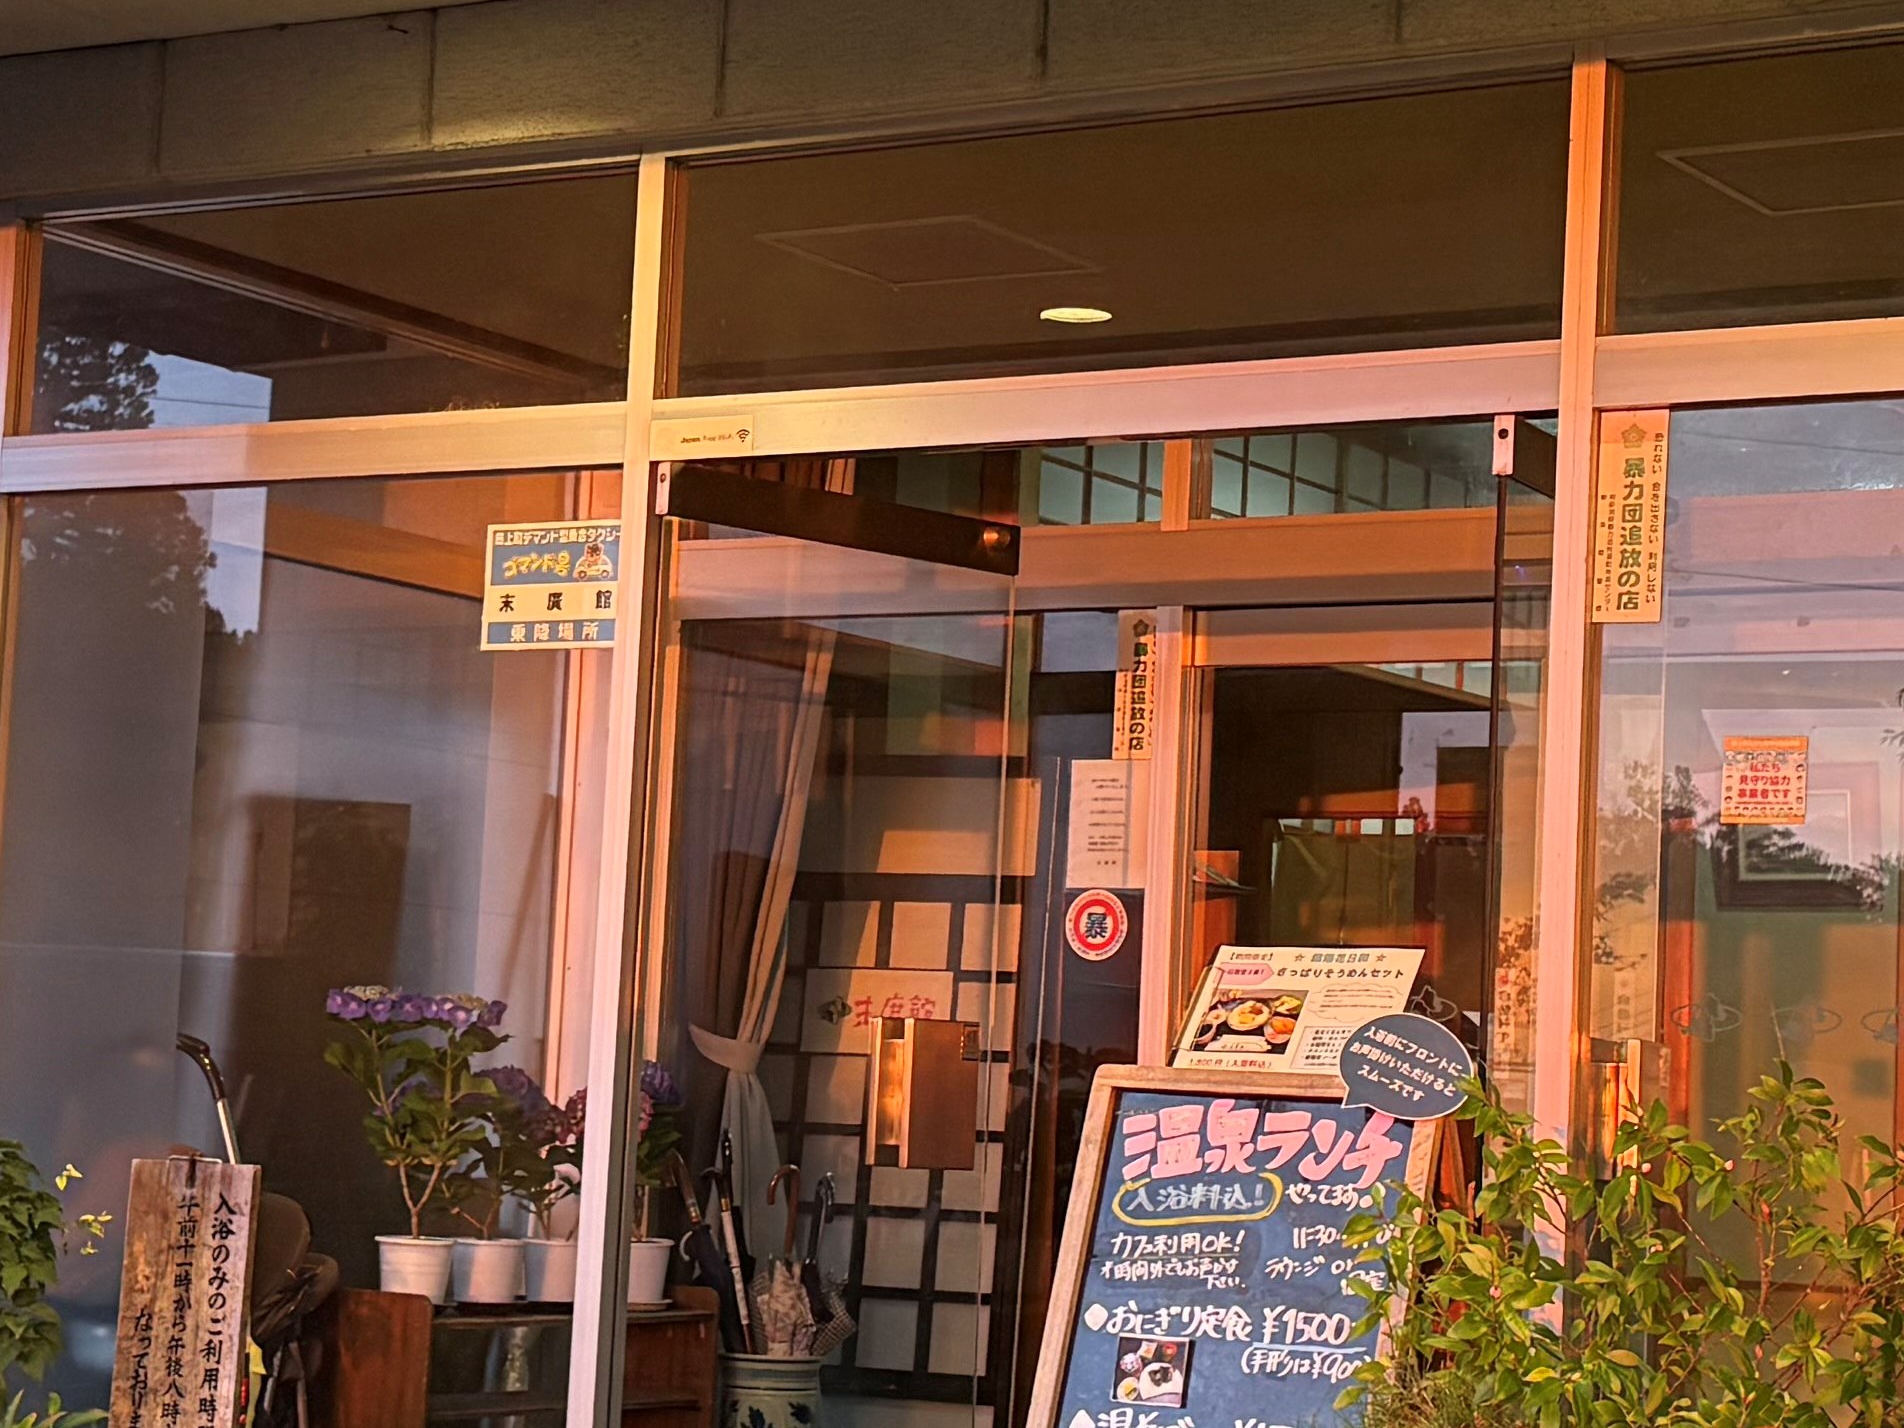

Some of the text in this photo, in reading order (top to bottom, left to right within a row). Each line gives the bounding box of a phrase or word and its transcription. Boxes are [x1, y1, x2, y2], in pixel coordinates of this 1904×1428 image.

[1616, 457, 1646, 611] 暴力団追放の店
[1739, 775, 1791, 786] 見守り協力
[1084, 912, 1109, 940] 暴
[1357, 1064, 1425, 1101] スムーズです
[1122, 1099, 1403, 1189] 温泉ランチ
[1106, 1300, 1252, 1342] おにぎり定食
